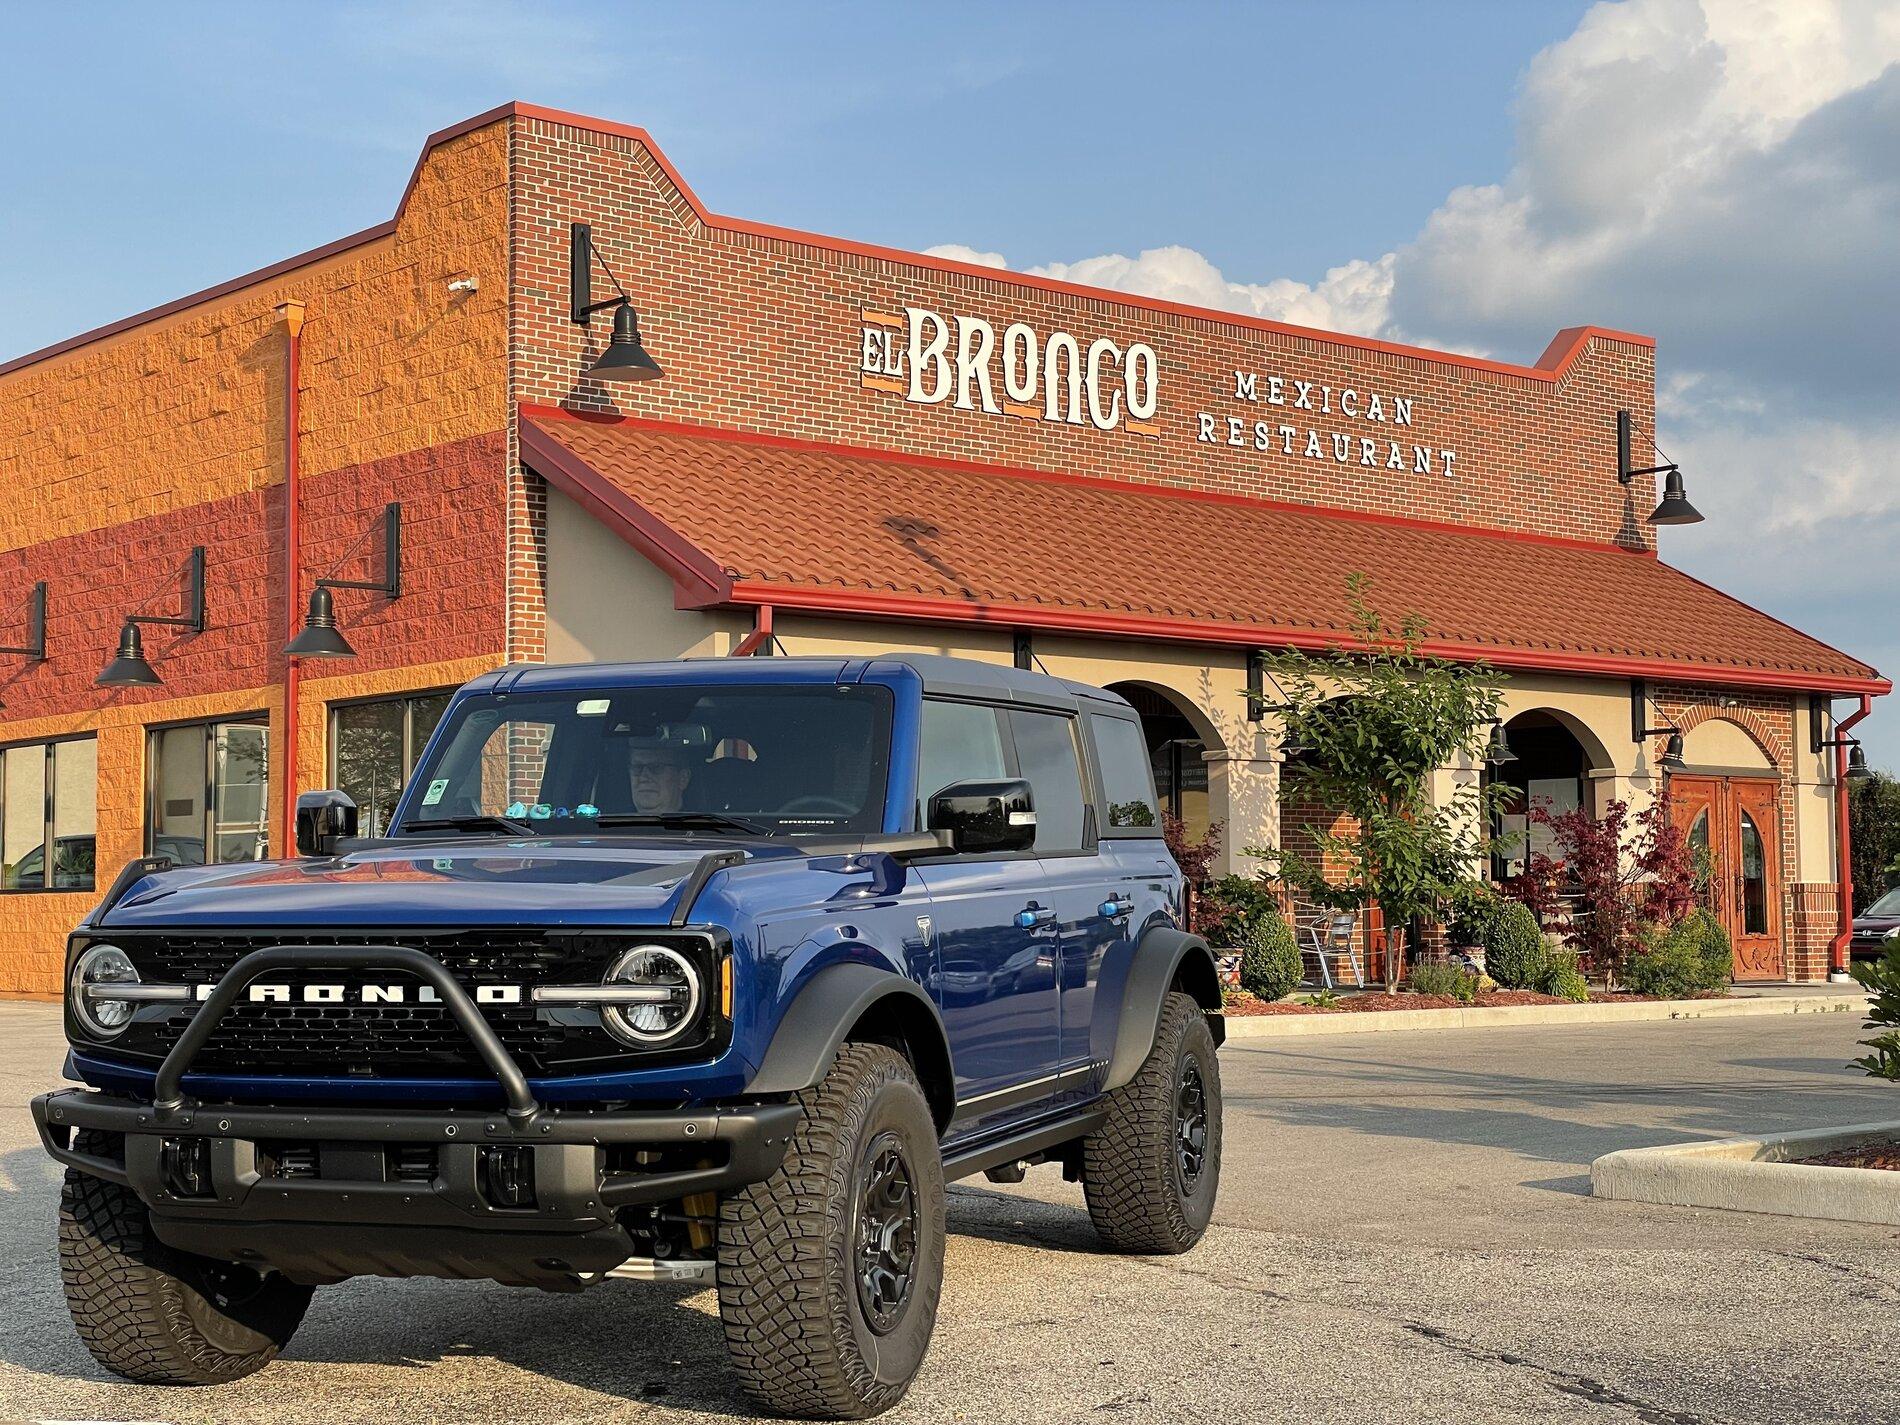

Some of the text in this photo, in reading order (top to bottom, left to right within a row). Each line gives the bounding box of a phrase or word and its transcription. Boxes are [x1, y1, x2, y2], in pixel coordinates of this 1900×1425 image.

[861, 307, 1160, 431] EL BRONCO
[1233, 370, 1413, 426] MEXICAN
[1197, 412, 1456, 477] RESTAURANT
